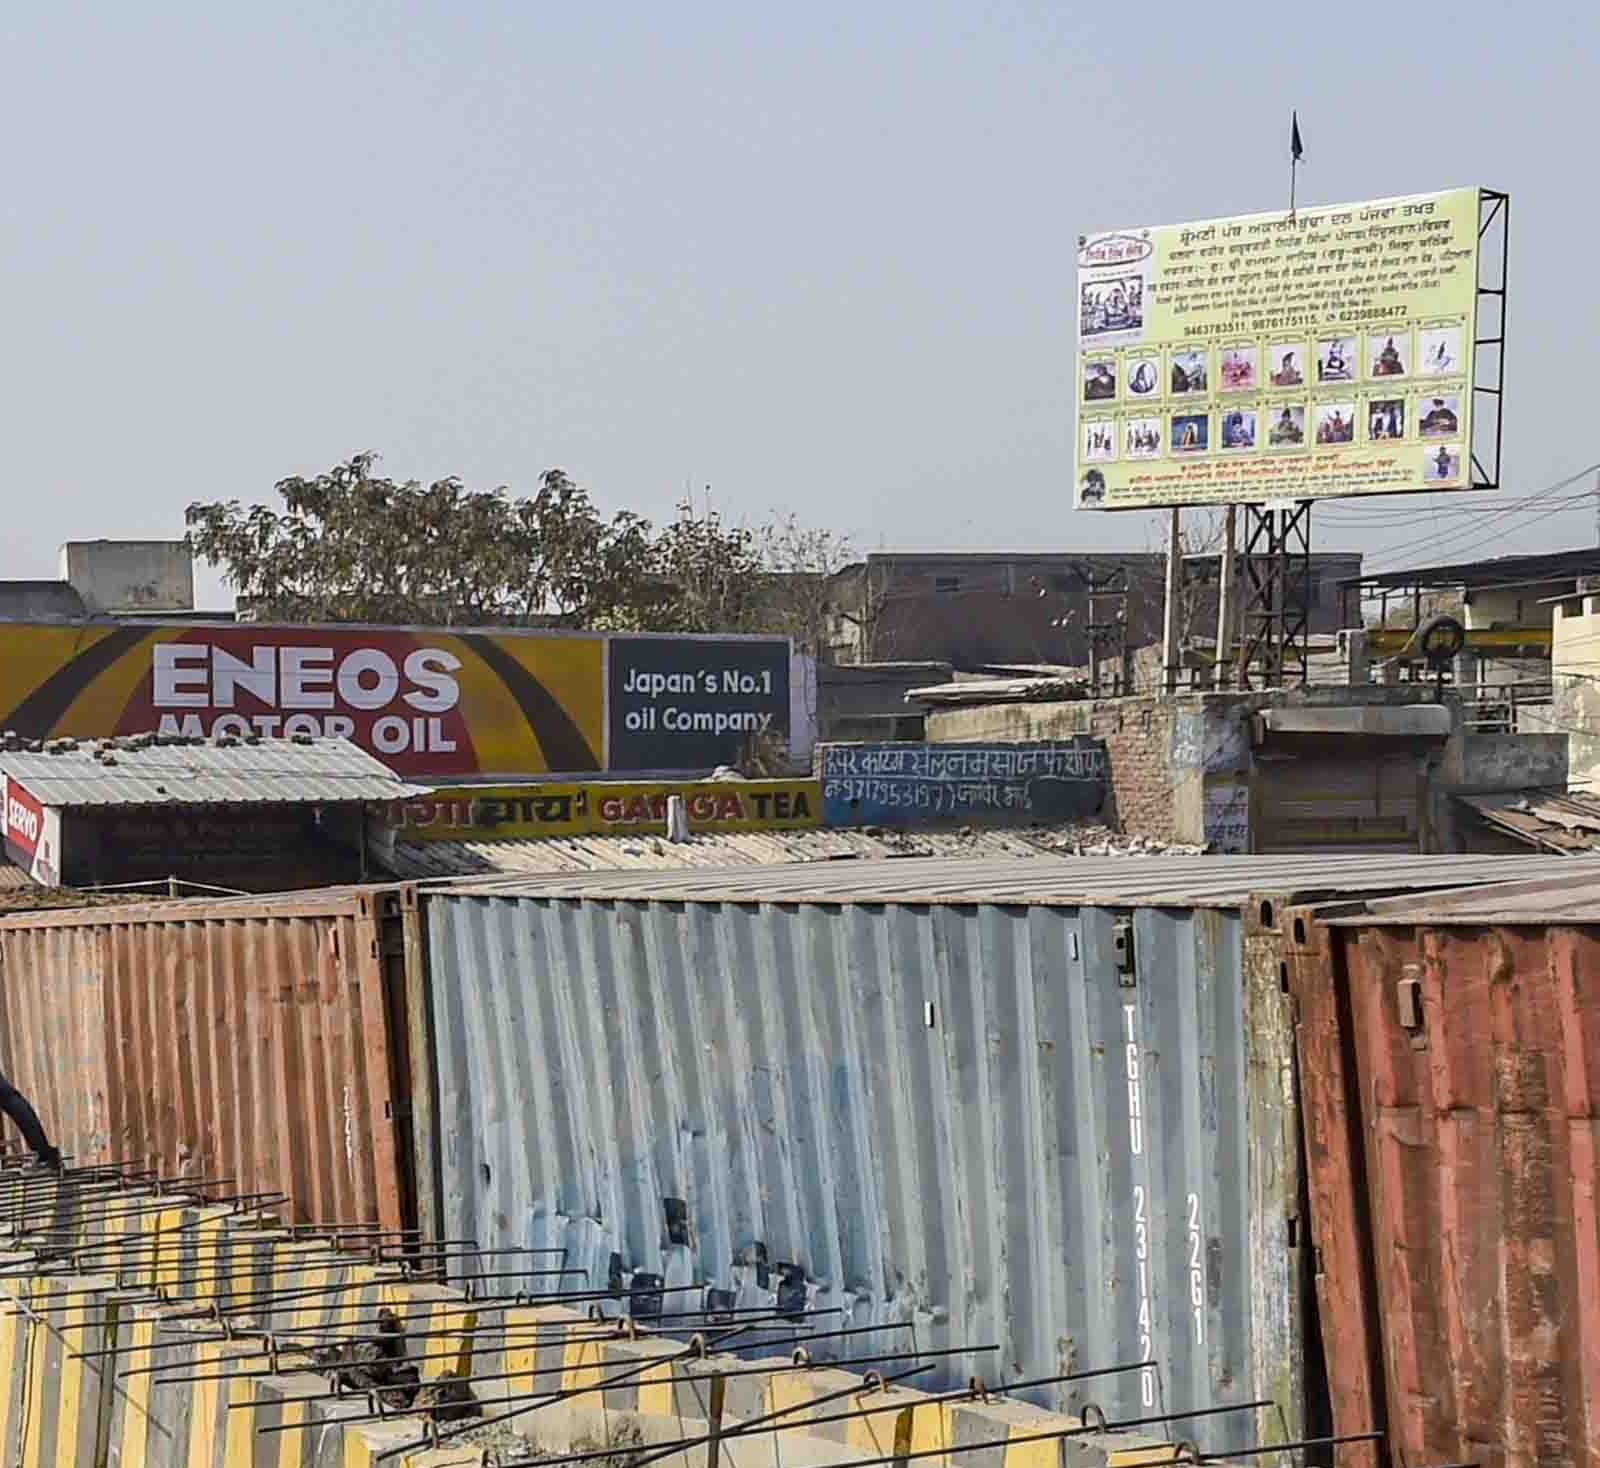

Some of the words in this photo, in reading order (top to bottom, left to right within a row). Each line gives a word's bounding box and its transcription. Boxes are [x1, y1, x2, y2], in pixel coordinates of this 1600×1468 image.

[152, 643, 464, 713] ENEOS
[722, 668, 773, 695] No.1
[371, 714, 458, 754] OIL
[625, 706, 657, 731] oil
[662, 706, 774, 737] Company
[8, 797, 38, 842] SERVO
[750, 792, 810, 820] TEA
[1123, 1004, 1143, 1154] TGHU
[1134, 1185, 1153, 1407] 231420
